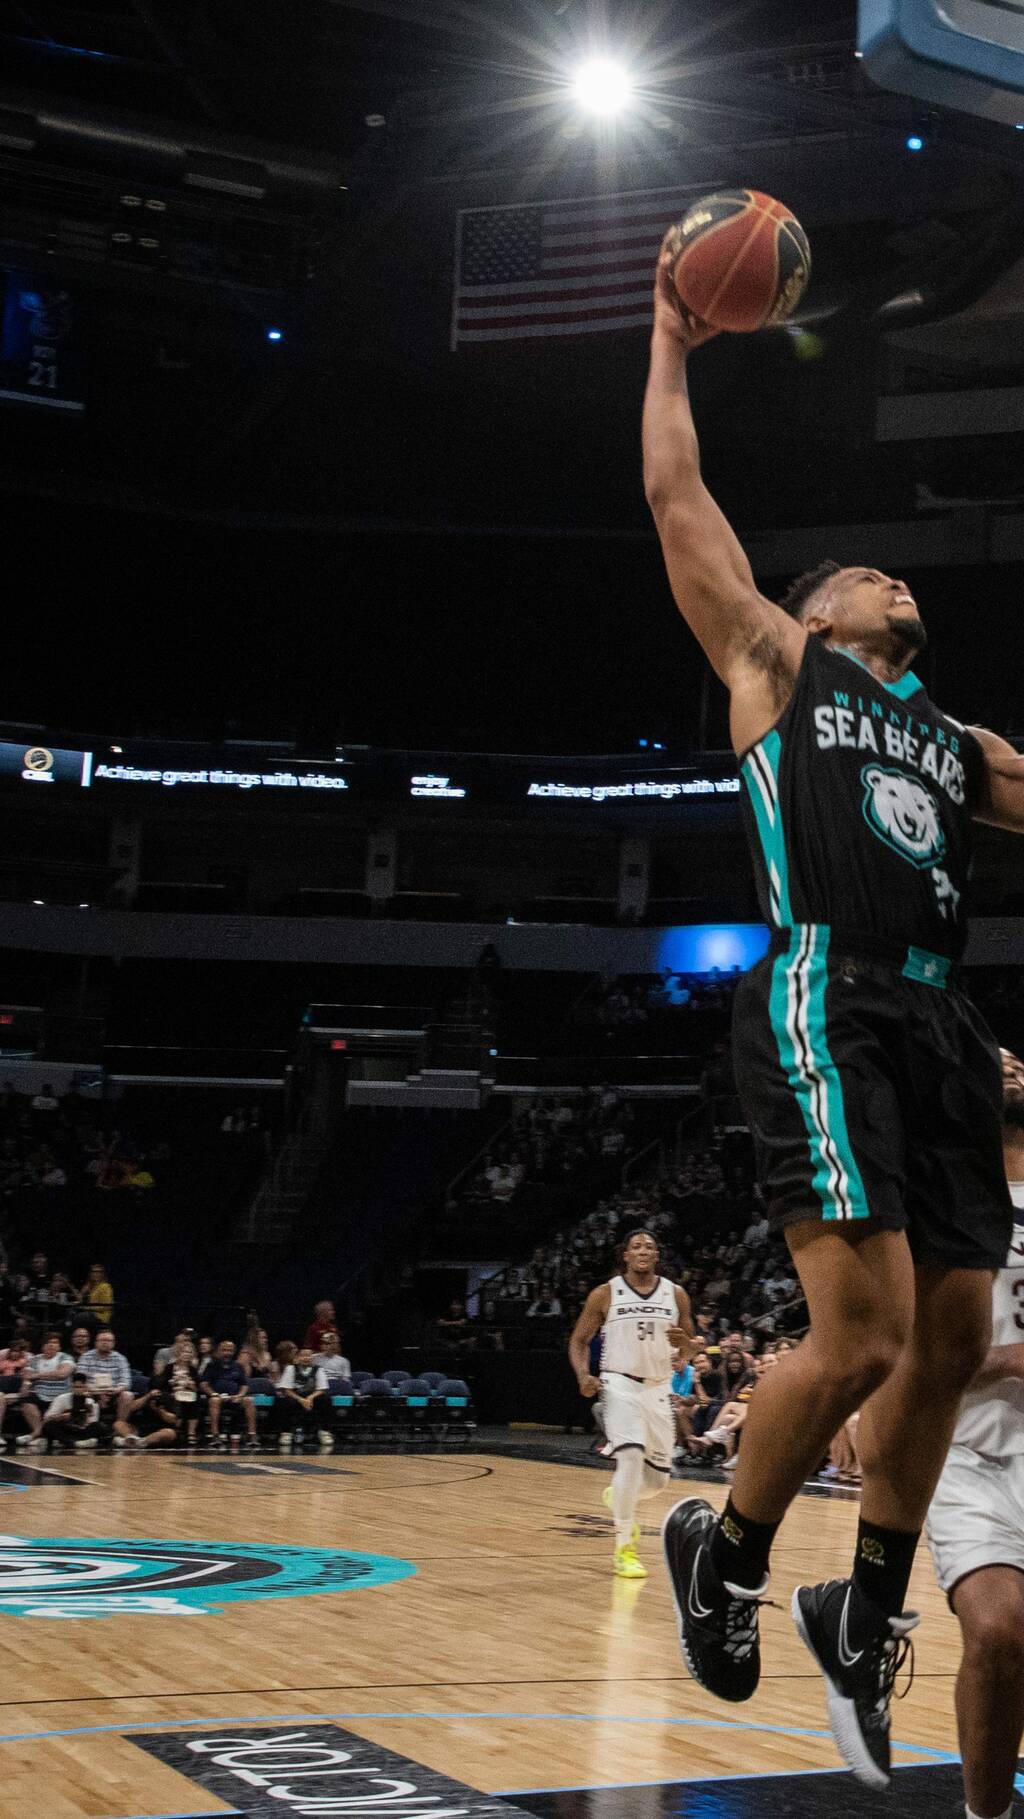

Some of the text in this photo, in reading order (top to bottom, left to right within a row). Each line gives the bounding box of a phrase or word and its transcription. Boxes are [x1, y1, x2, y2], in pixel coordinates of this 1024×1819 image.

[814, 705, 965, 805] SEA BEARS
[94, 763, 162, 783] Achieve
[162, 770, 209, 789] great
[209, 769, 261, 792] things
[261, 771, 298, 790] with
[528, 782, 592, 798] Achieve
[592, 782, 634, 801] great
[634, 781, 682, 799] things
[682, 779, 715, 795] with
[638, 1321, 655, 1341] 54
